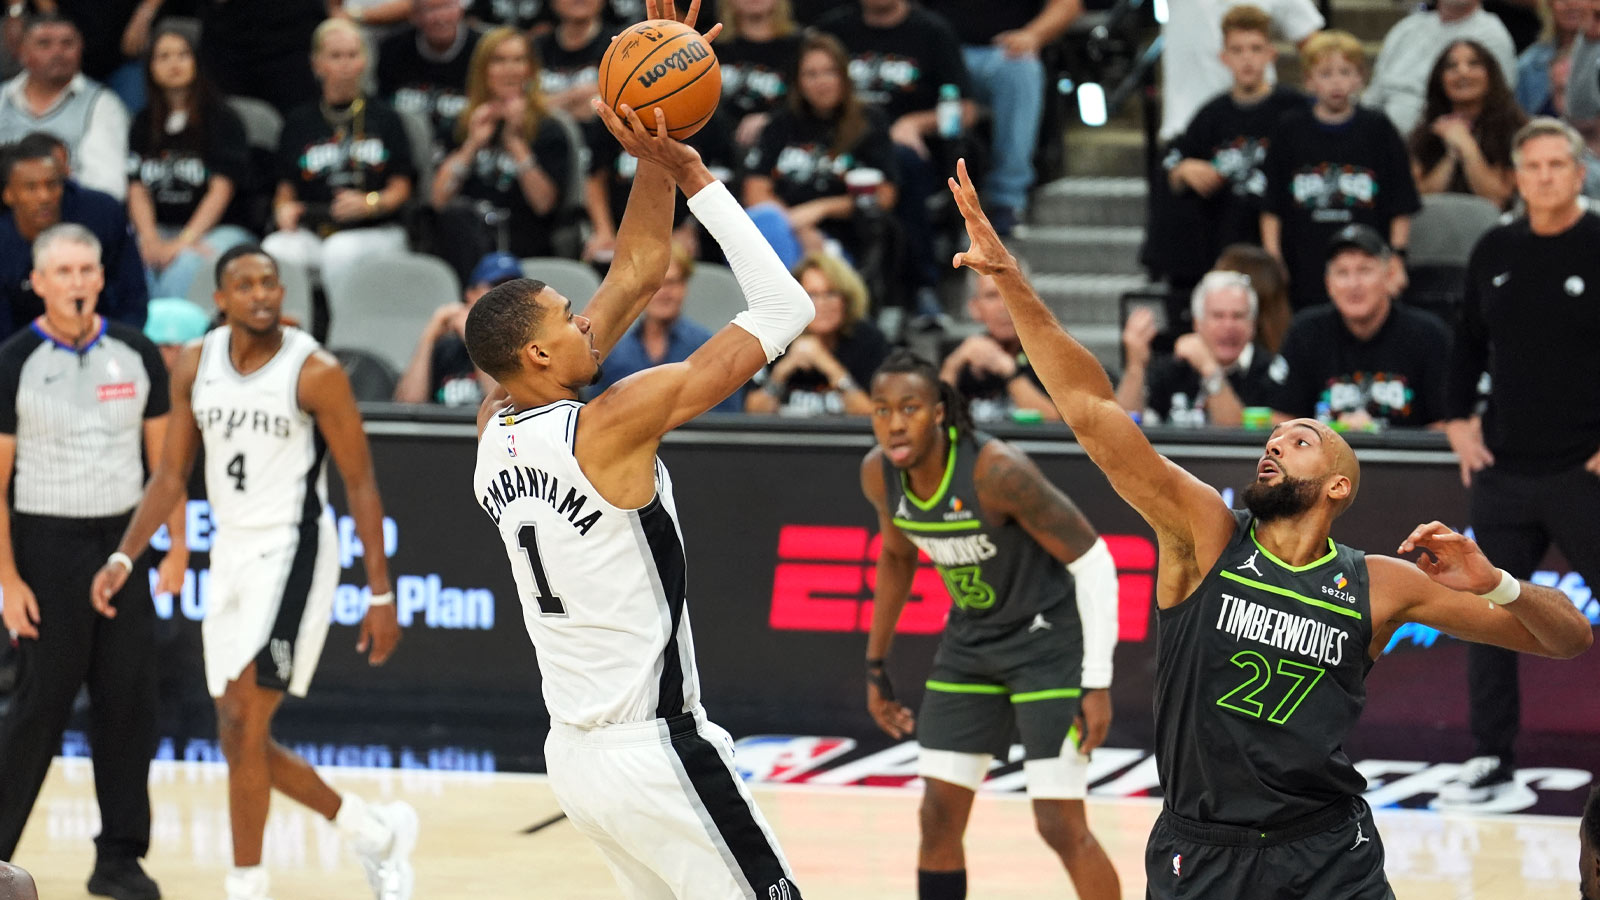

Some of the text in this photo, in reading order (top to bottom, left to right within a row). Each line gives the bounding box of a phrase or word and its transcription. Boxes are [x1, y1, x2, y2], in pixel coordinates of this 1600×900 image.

[637, 41, 710, 88] Wilson
[226, 453, 246, 491] 4
[482, 465, 603, 536] EMBANYAMA
[514, 520, 569, 618] 1
[1321, 585, 1356, 604] sezzle
[396, 573, 495, 630] Plan
[1216, 593, 1349, 666] TIMBERWOLVES
[1216, 650, 1326, 725] 27
